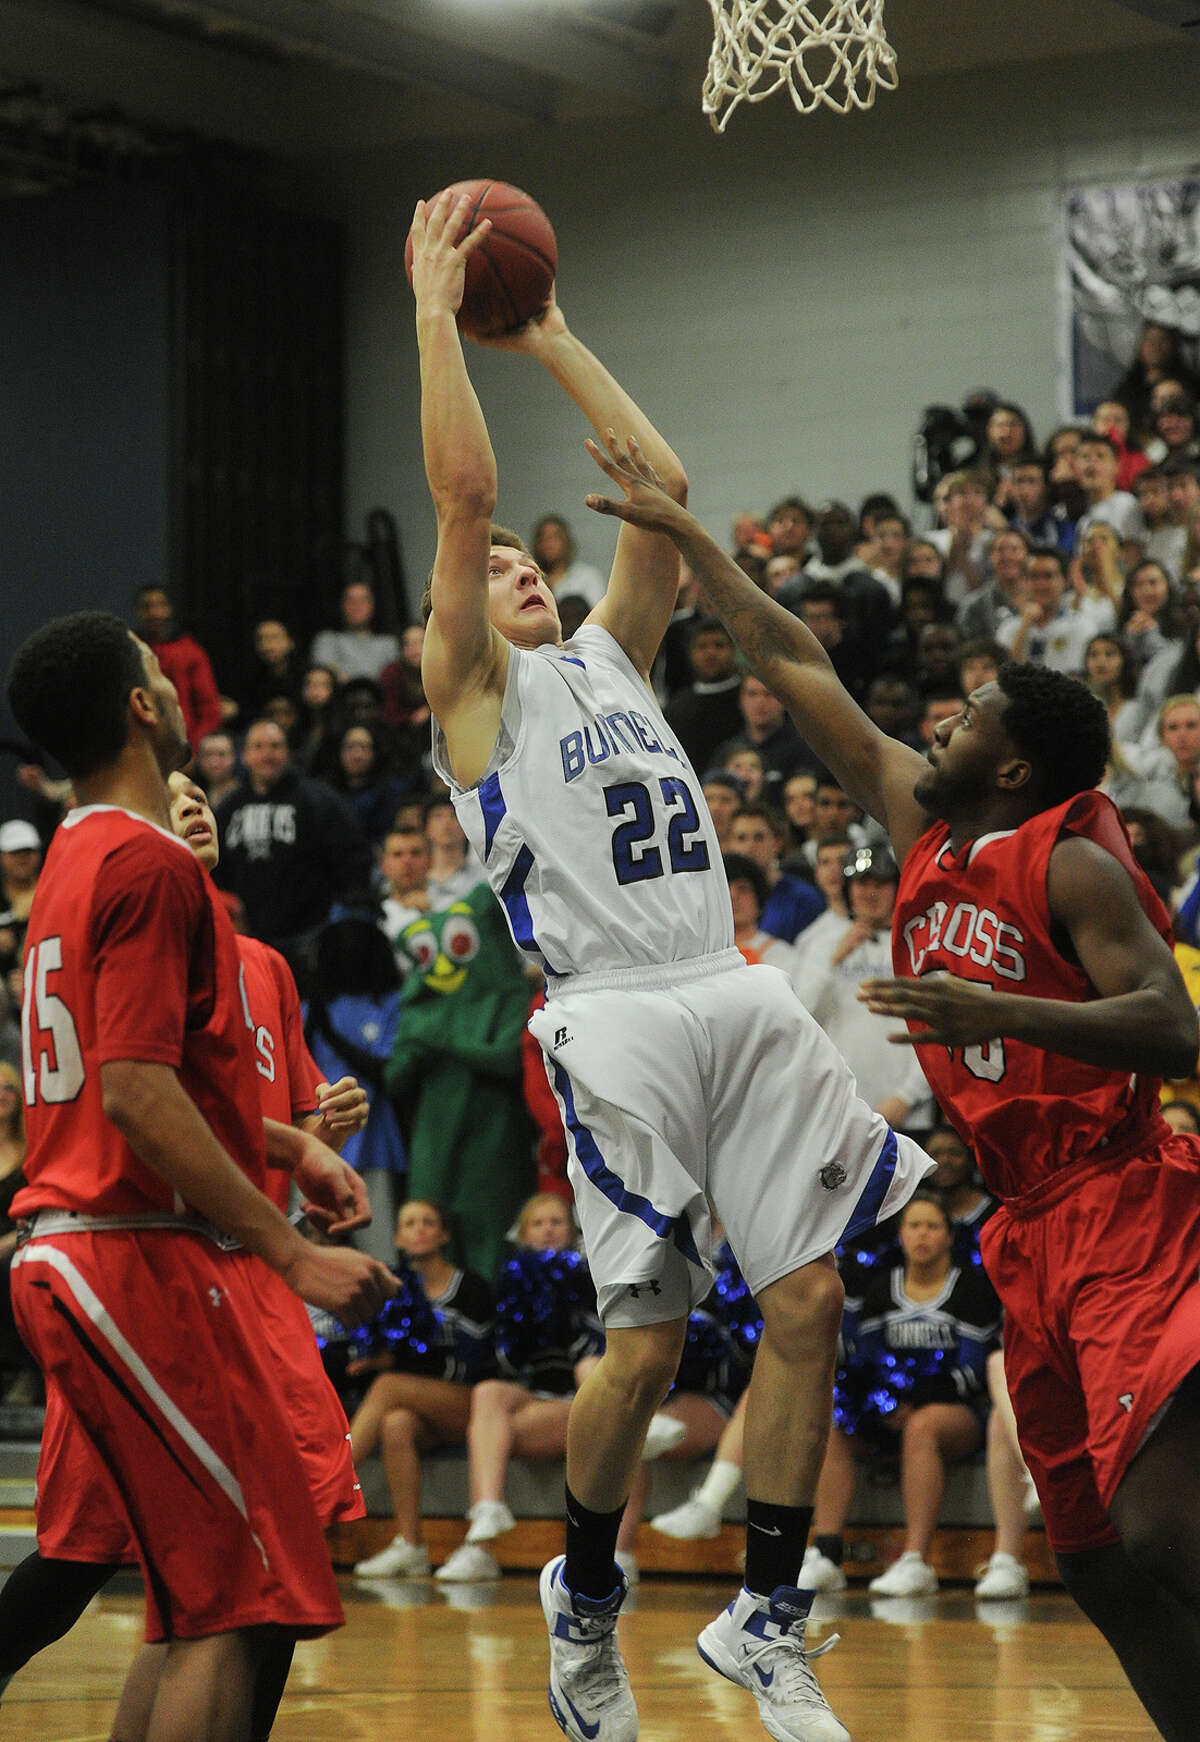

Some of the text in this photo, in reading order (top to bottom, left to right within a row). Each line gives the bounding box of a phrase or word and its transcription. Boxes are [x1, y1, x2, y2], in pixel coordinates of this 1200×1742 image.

[602, 776, 711, 886] 22
[903, 901, 1026, 981] CROSS
[21, 934, 86, 1106] 15
